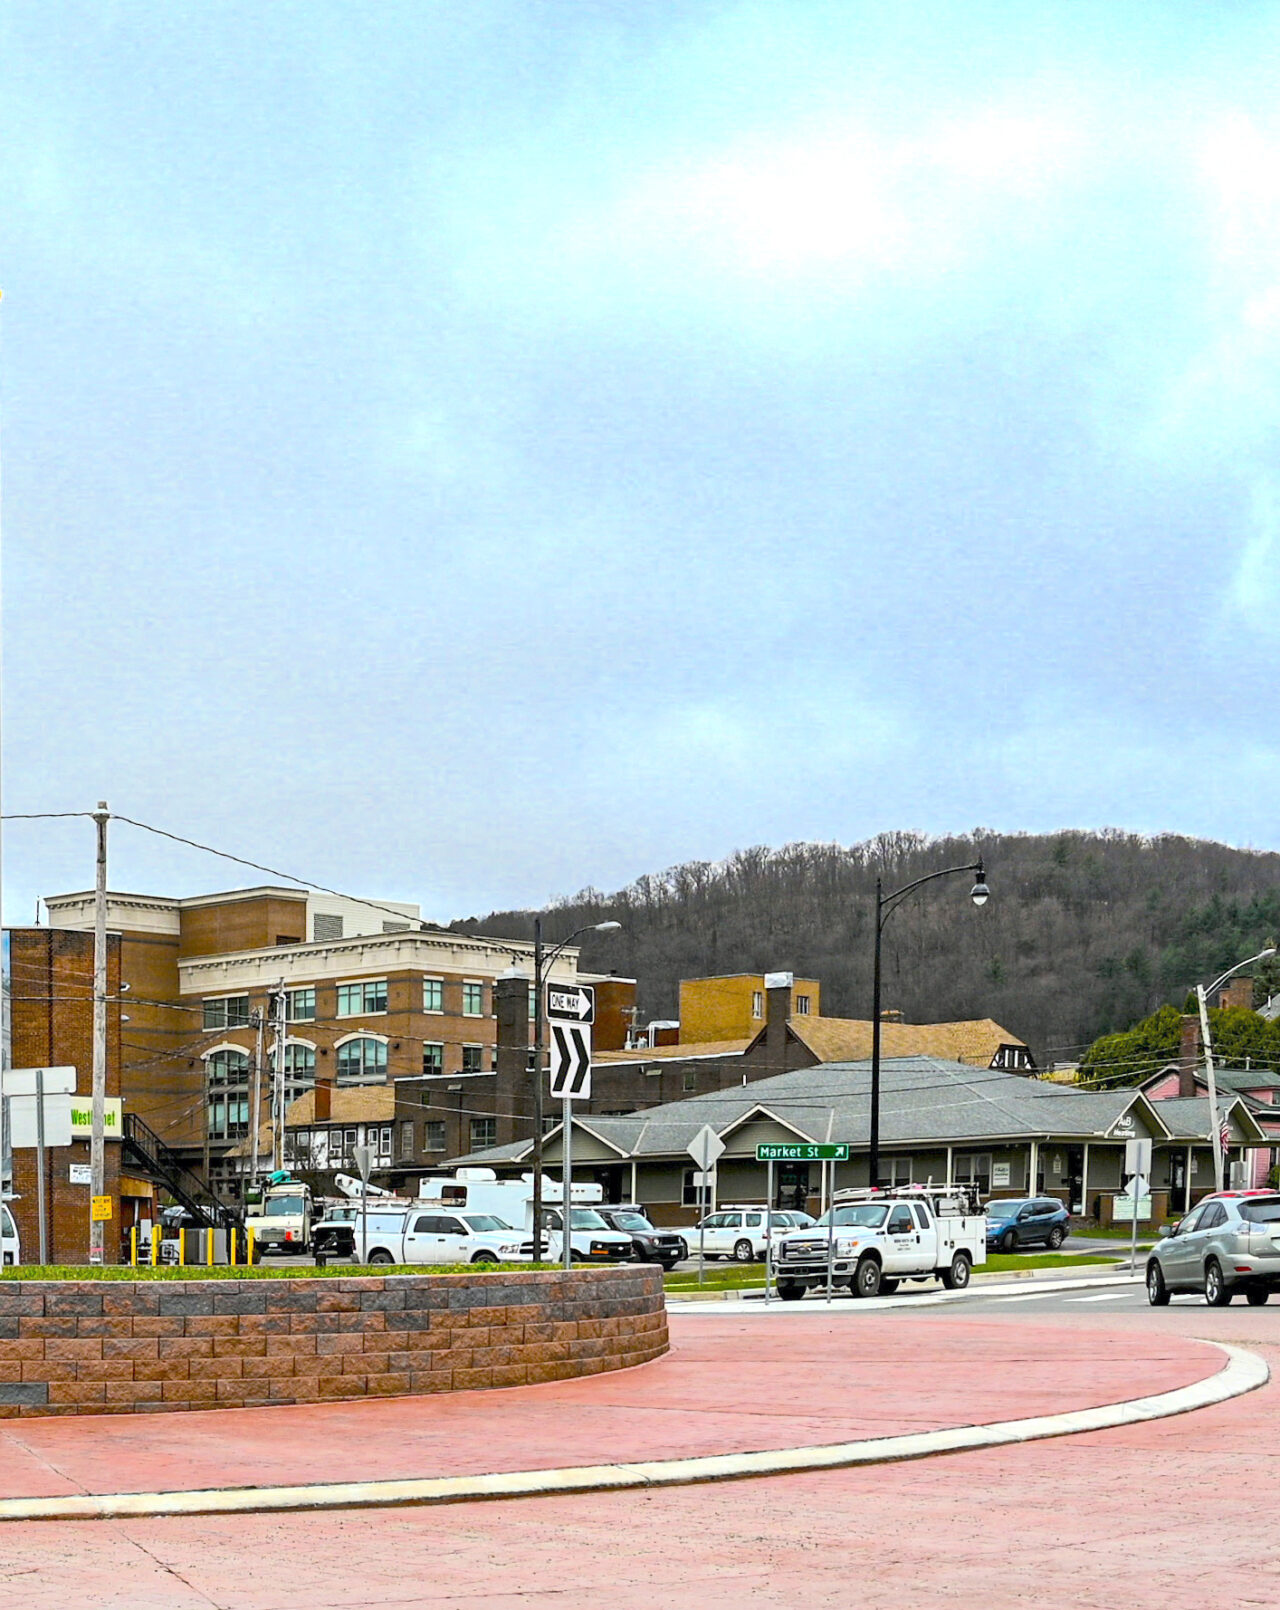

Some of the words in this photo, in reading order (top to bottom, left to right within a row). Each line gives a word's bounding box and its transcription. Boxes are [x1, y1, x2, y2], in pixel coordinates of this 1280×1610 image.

[551, 994, 565, 1009] ONE
[566, 996, 580, 1010] WAY
[760, 1146, 802, 1158] Market
[807, 1146, 819, 1158] St
